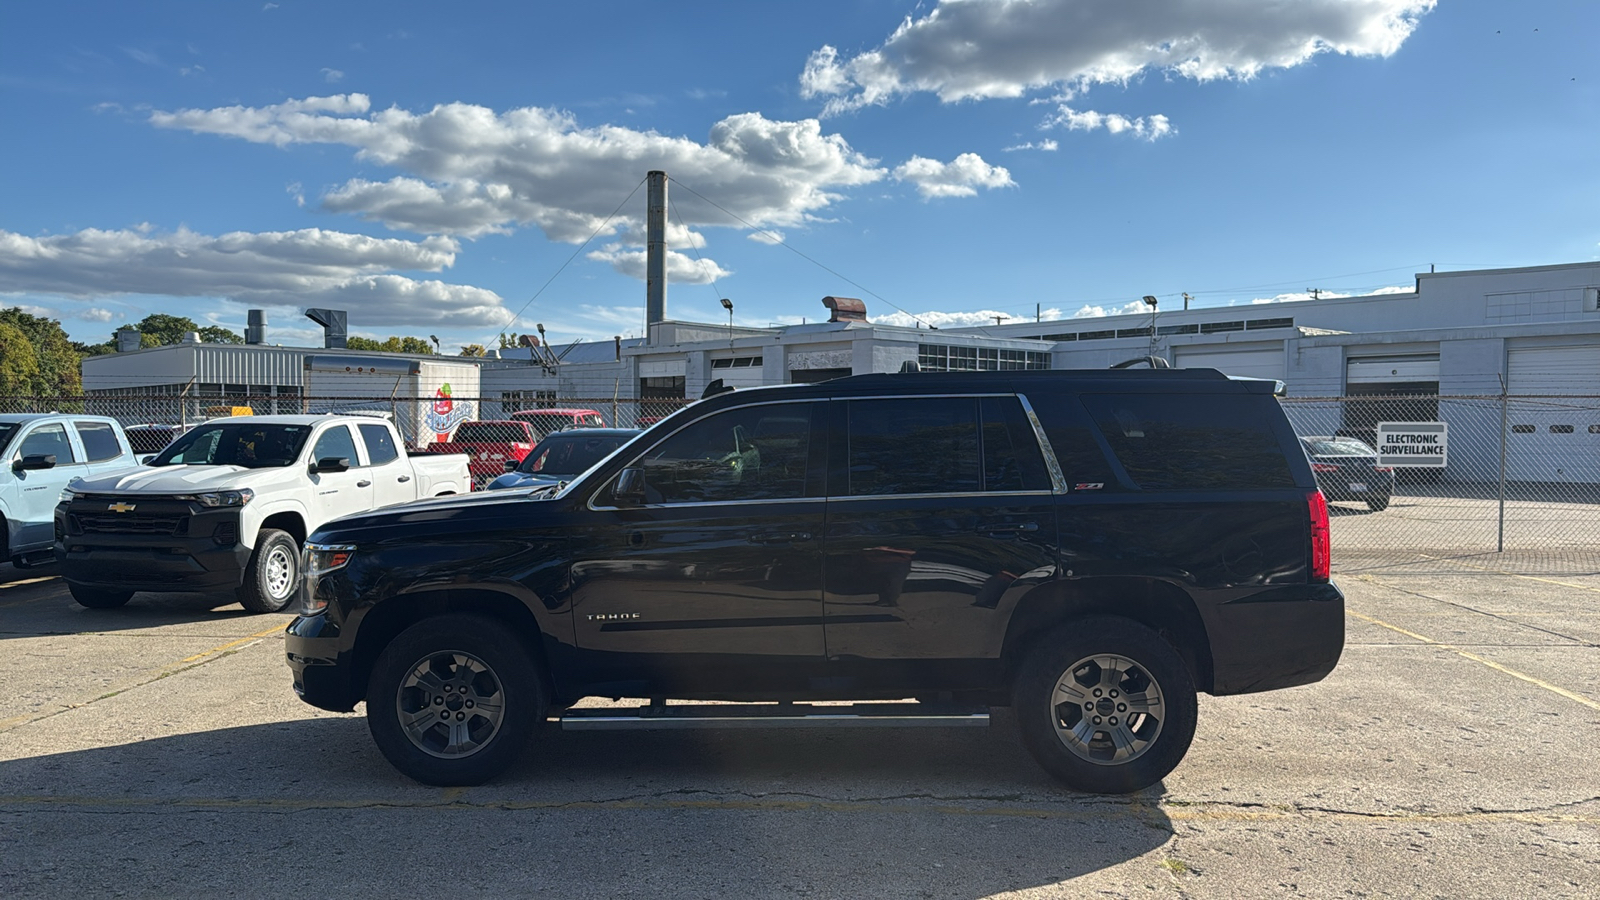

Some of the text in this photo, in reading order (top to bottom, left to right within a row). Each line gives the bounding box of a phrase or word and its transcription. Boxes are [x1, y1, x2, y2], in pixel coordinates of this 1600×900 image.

[1386, 434, 1438, 444] ELECTRONIC
[1380, 445, 1444, 455] SURVEILLANCE
[586, 612, 641, 621] TAHOE
